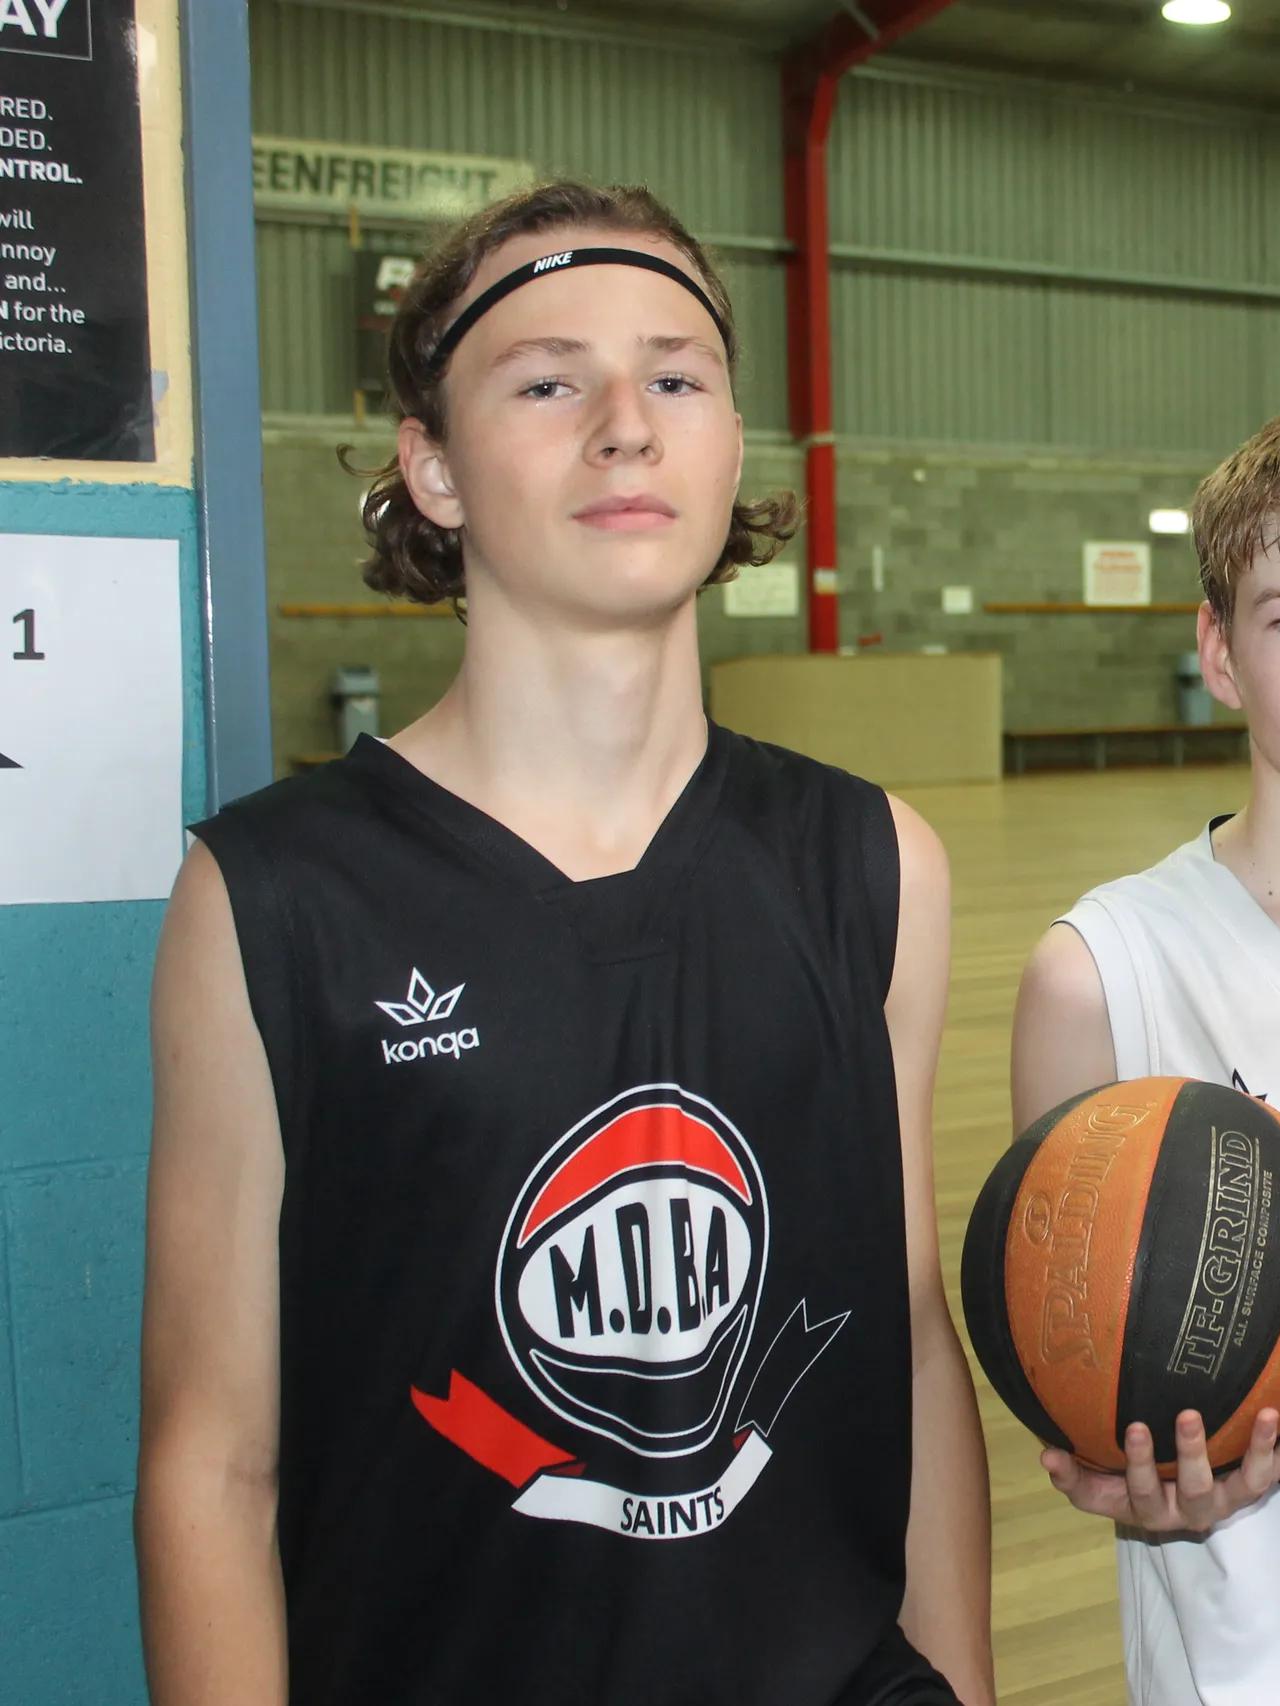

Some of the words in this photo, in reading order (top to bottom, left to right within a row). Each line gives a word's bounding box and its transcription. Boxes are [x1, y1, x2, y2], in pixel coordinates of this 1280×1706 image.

[4, 271, 67, 293] and...
[533, 251, 573, 274] NIKE
[13, 301, 47, 322] for
[50, 303, 86, 325] the
[12, 608, 46, 661] 1
[381, 1026, 480, 1064] konqa
[1038, 1102, 1152, 1369] SPALDING
[1173, 1130, 1254, 1376] TF-GRIND
[1234, 1321, 1248, 1347] ALL
[1242, 1250, 1264, 1316] SURFACE
[1257, 1170, 1273, 1247] COMPOSITE
[549, 1197, 730, 1339] M.D.BA
[620, 1485, 725, 1536] SAINTS
